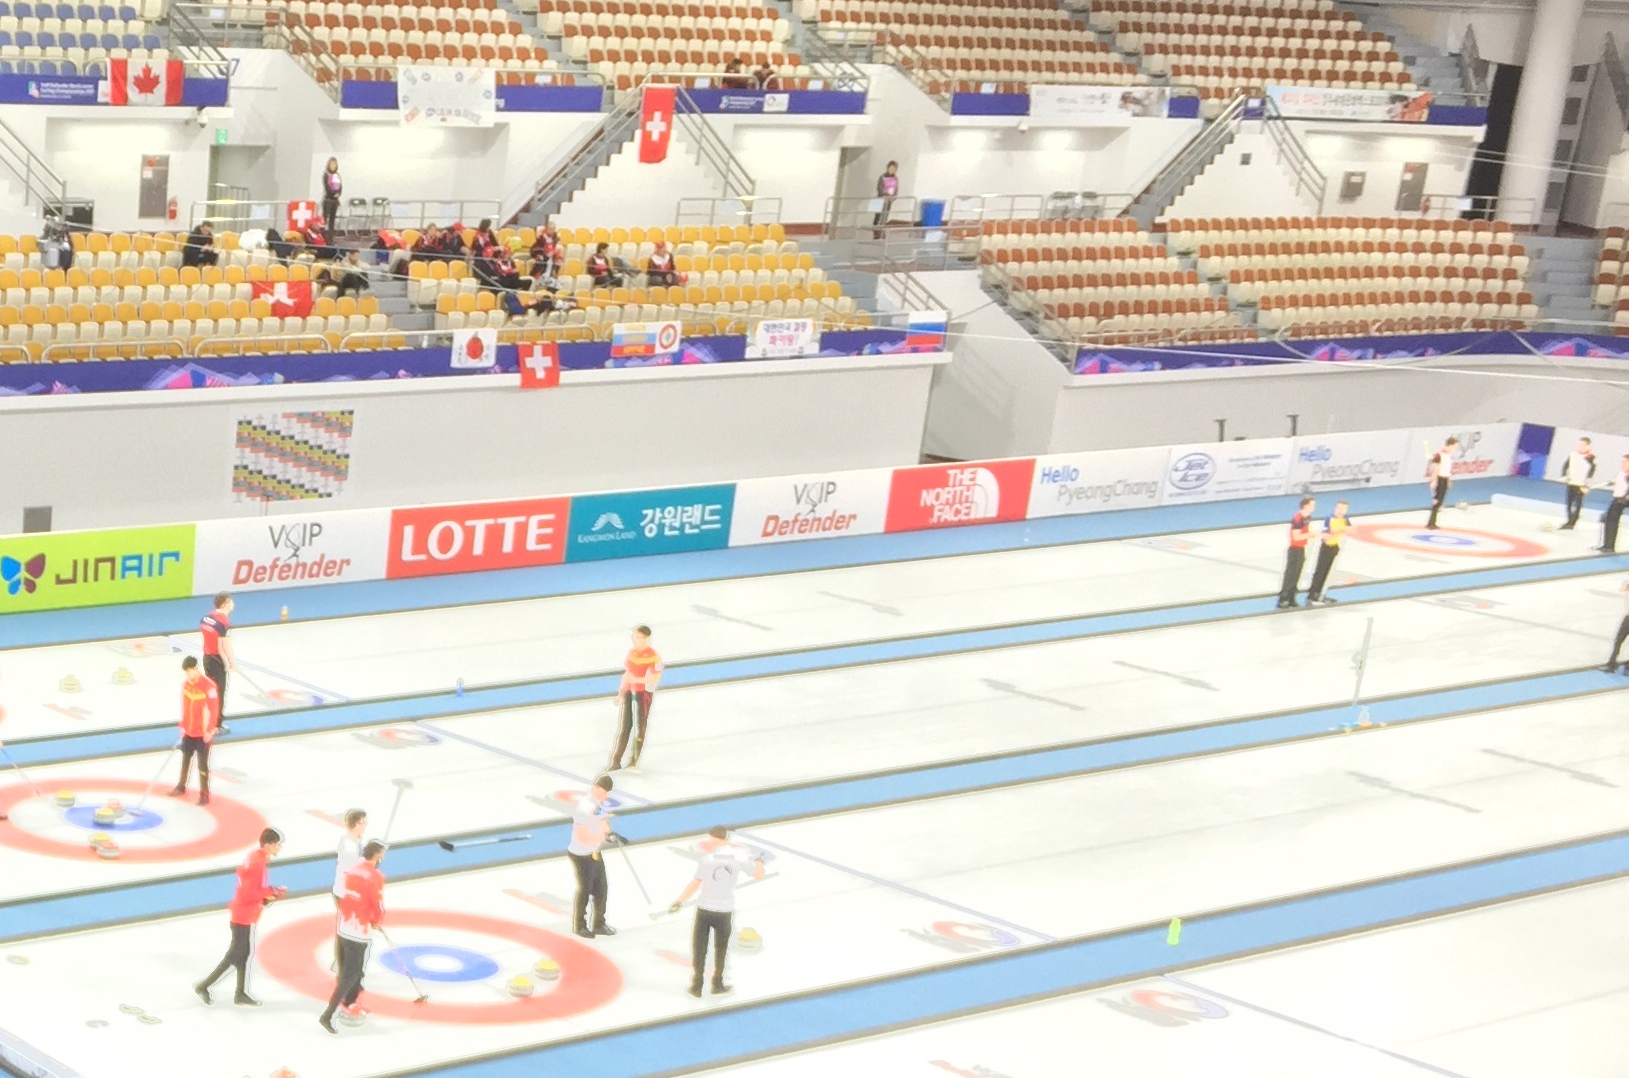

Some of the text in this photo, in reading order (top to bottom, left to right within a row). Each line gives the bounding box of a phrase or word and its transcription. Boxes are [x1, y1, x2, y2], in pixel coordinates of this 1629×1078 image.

[947, 467, 978, 487] THE
[1041, 464, 1080, 484] Hello
[920, 485, 974, 507] NORTH
[1057, 479, 1158, 506] PyeongChang
[640, 503, 722, 538] 강원랜드
[761, 509, 857, 538] Defender
[932, 503, 972, 524] FACE
[401, 513, 556, 562] LOTTE
[232, 553, 351, 585] Defender
